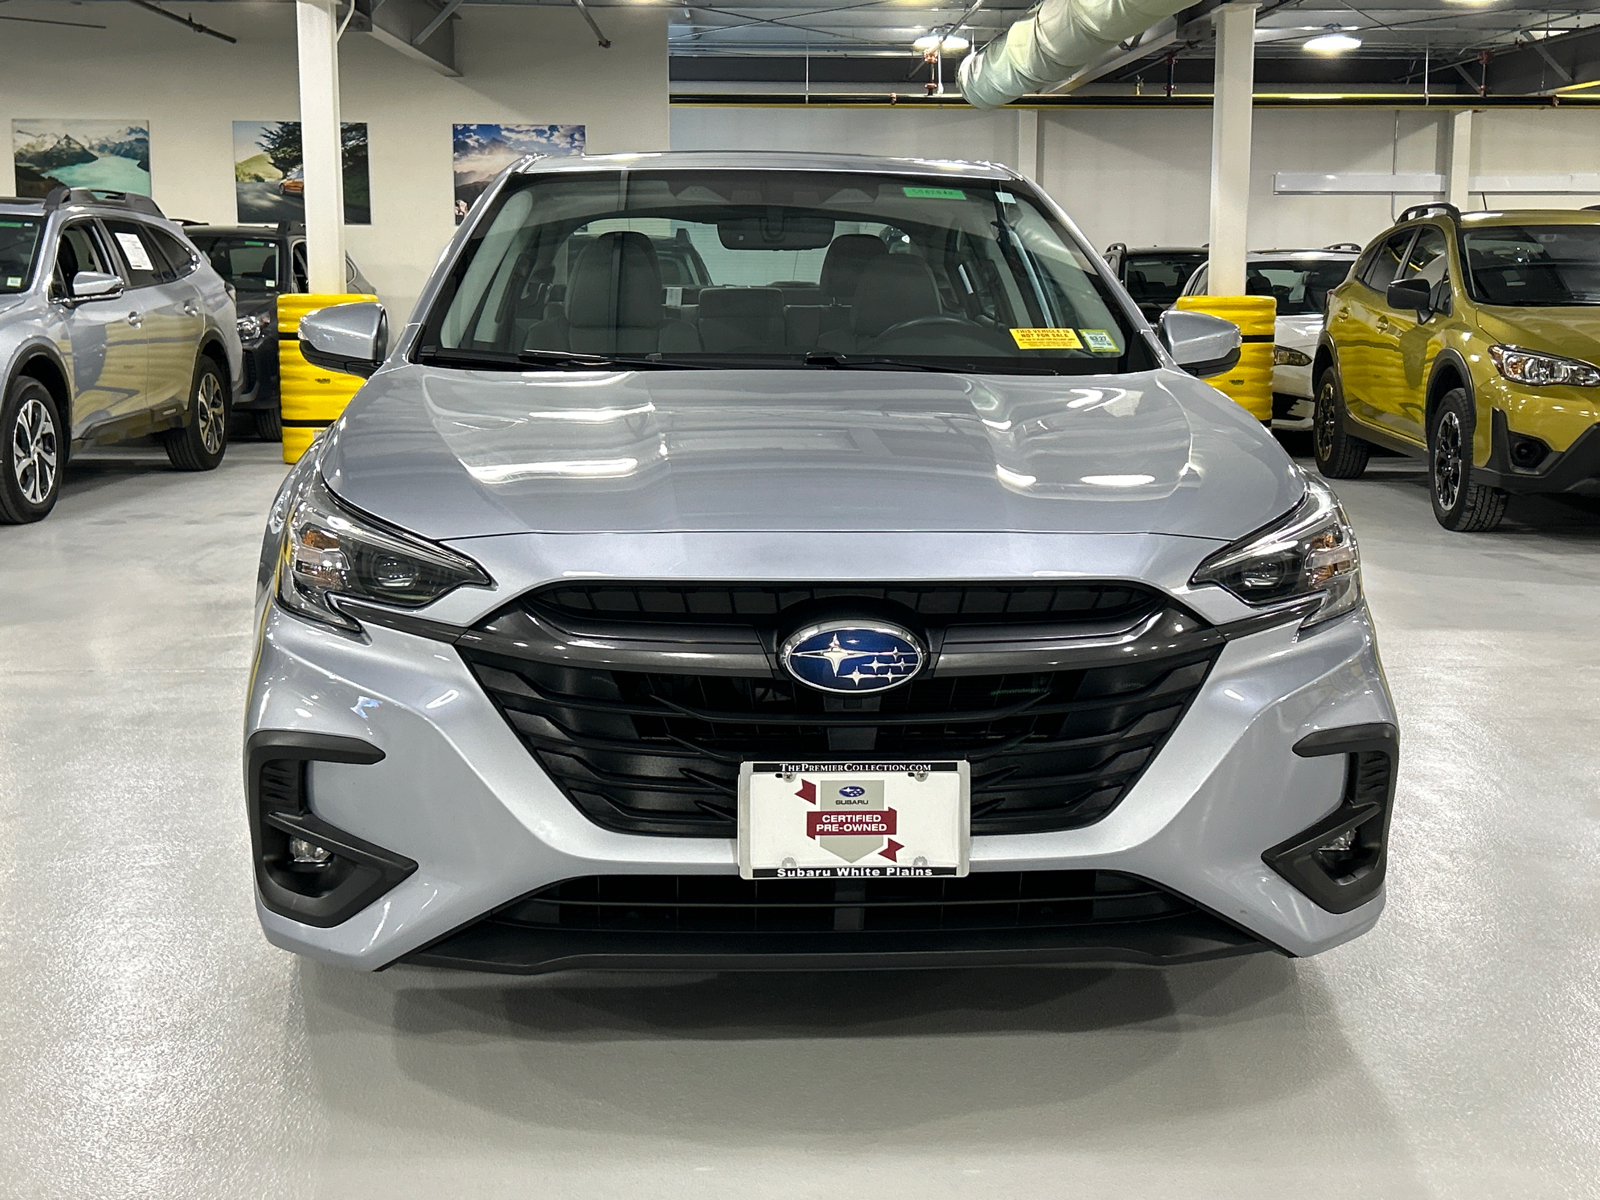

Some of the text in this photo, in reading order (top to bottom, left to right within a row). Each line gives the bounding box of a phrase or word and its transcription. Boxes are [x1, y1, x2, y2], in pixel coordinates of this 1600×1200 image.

[822, 814, 881, 823] CERTIFIED
[816, 824, 887, 832] PRE-OWNED
[777, 867, 933, 877] Subaru White Plains
